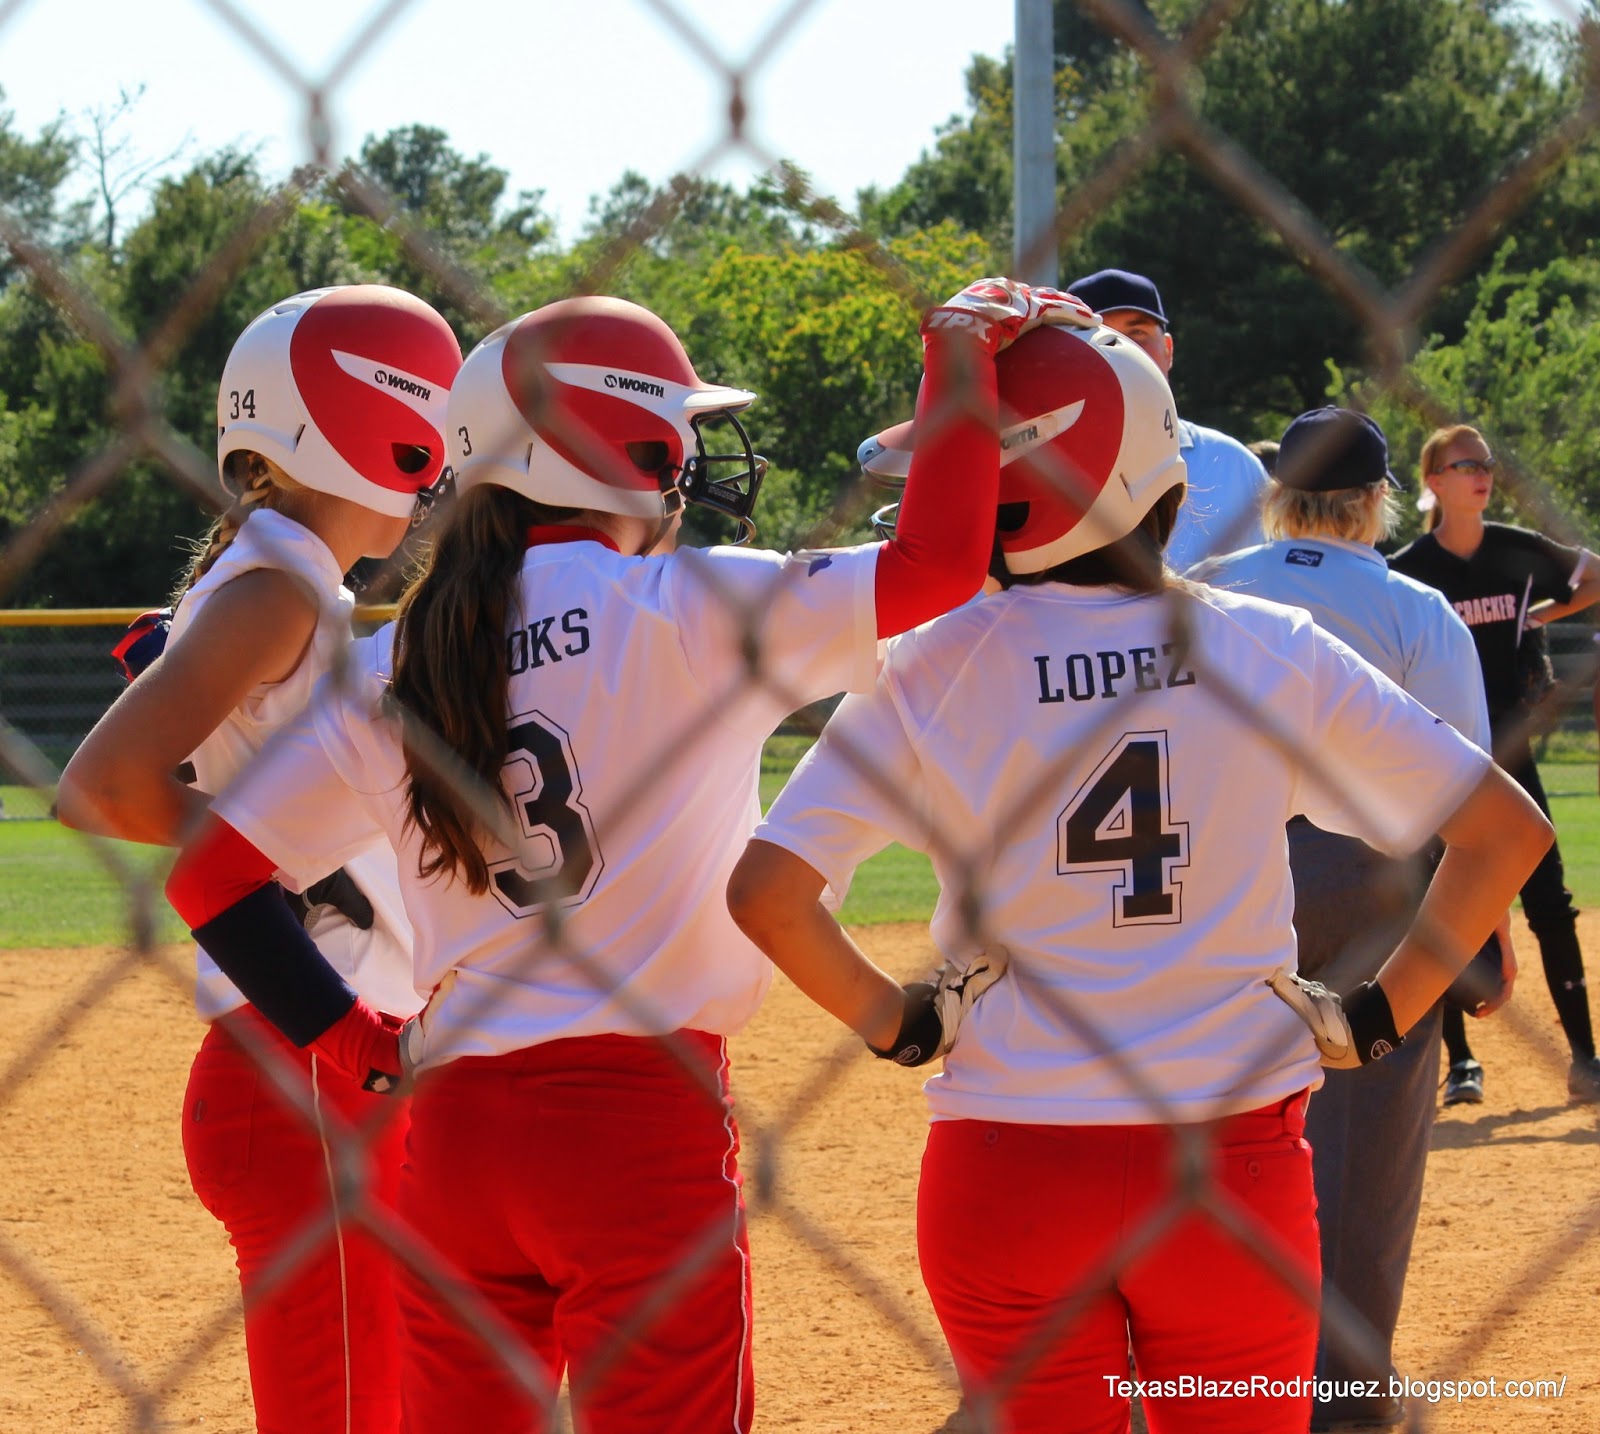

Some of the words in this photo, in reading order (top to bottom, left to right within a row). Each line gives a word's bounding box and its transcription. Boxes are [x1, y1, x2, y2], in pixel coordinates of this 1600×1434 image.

[928, 311, 993, 343] TPX
[387, 373, 431, 401] WORTH
[618, 376, 665, 399] WORTH
[230, 389, 255, 420] 34
[1163, 408, 1174, 439] 4
[458, 426, 472, 457] 3
[1452, 594, 1516, 625] CRACKER
[1034, 643, 1196, 704] LOPEZ
[489, 709, 605, 919] 3
[1057, 729, 1190, 928] 4
